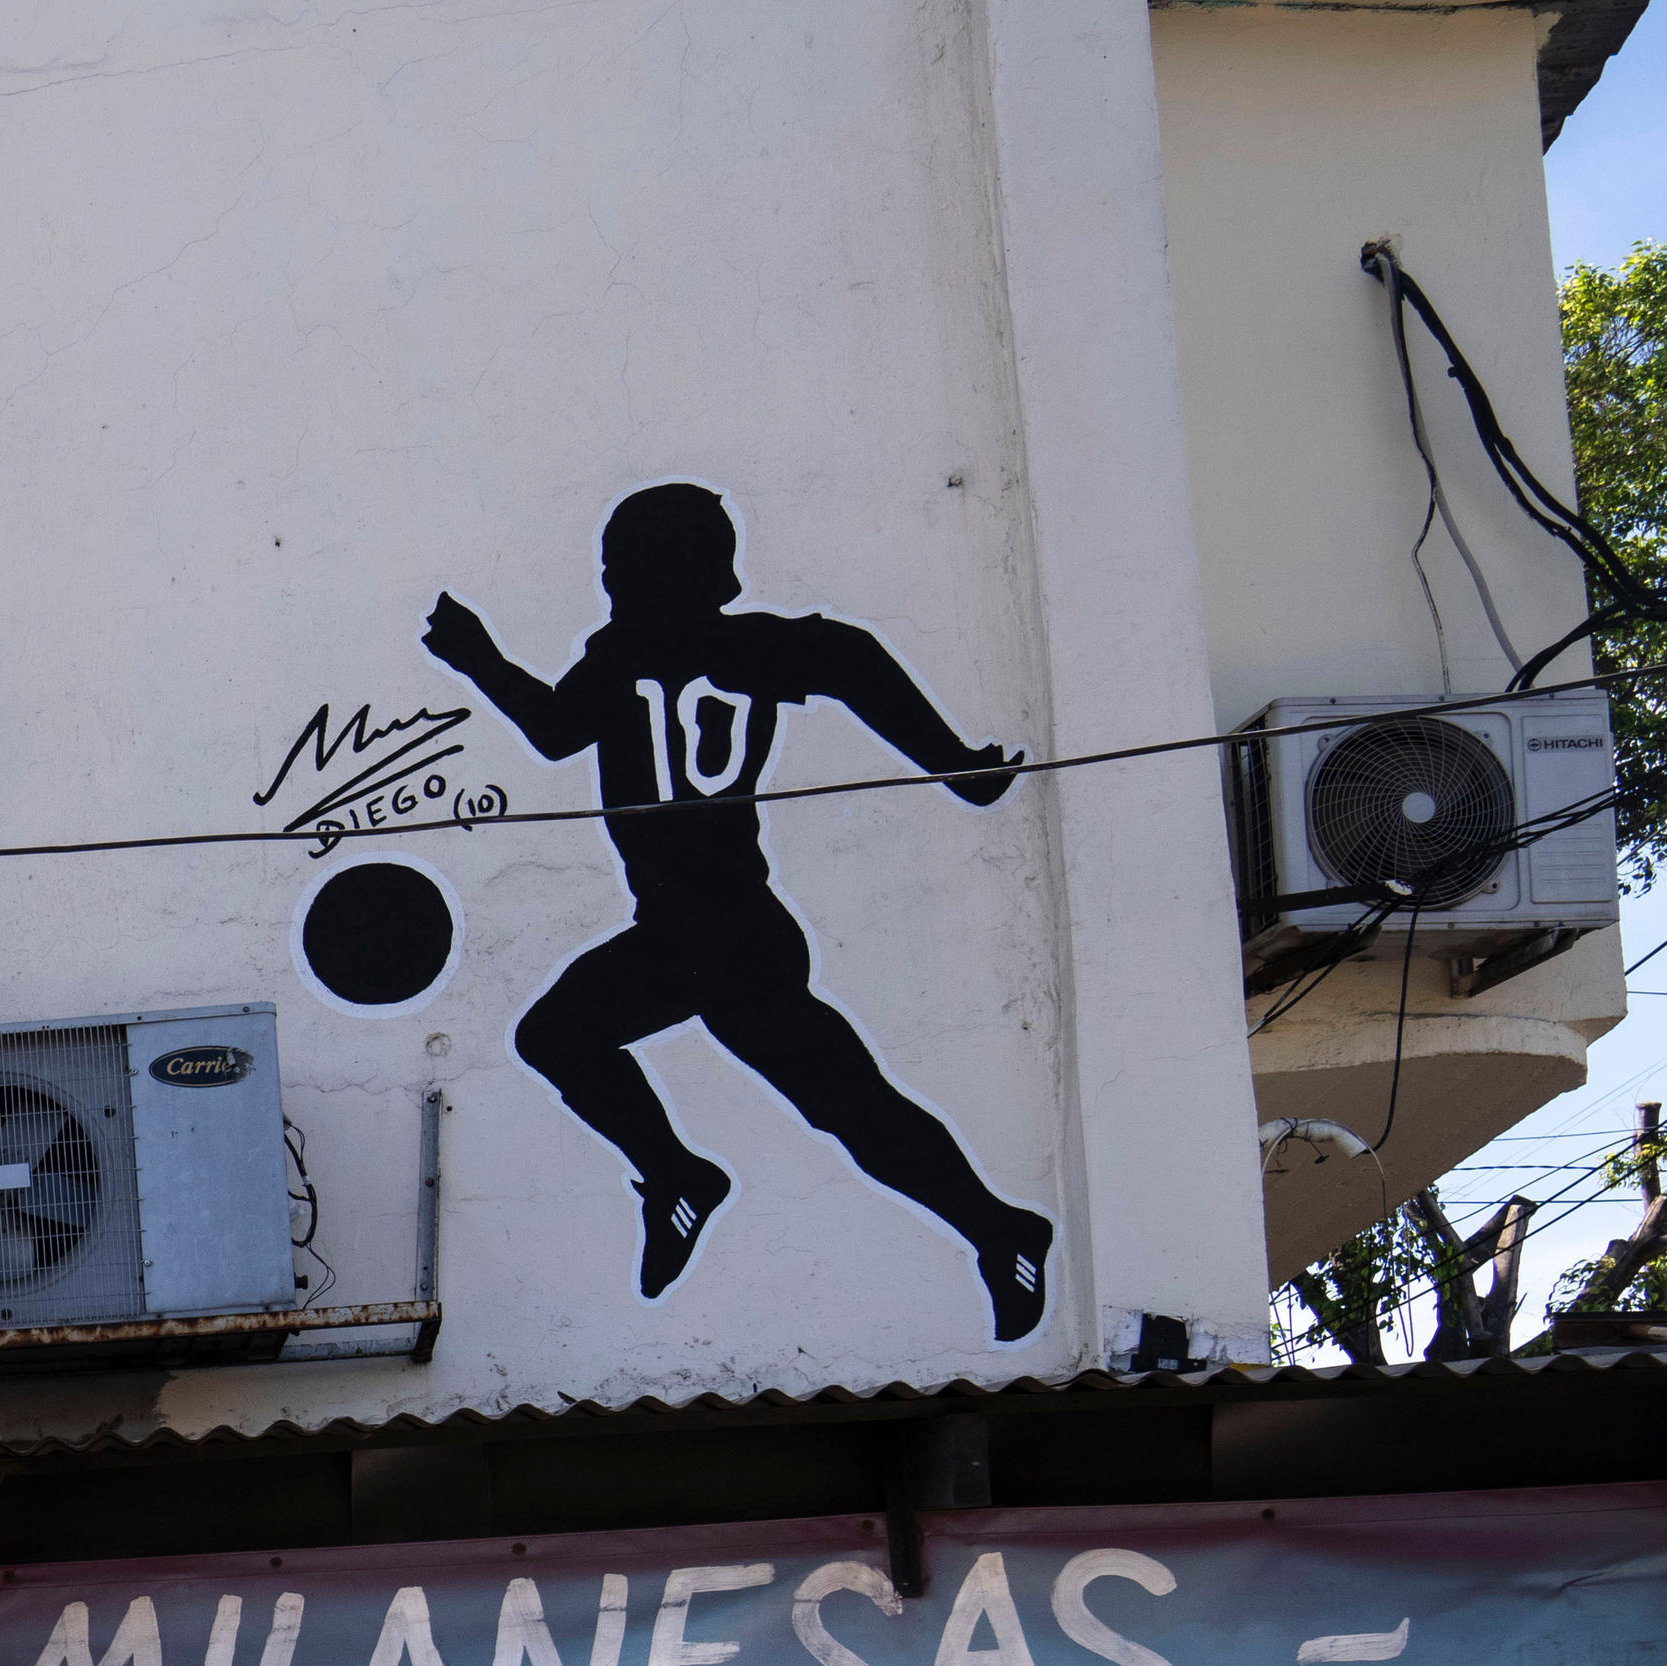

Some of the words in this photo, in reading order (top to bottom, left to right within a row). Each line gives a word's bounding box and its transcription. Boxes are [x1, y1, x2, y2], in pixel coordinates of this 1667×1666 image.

[635, 675, 753, 803] 10
[1543, 737, 1604, 751] HITACHI
[307, 774, 447, 860] DIEGO
[166, 1056, 234, 1076] Carrie
